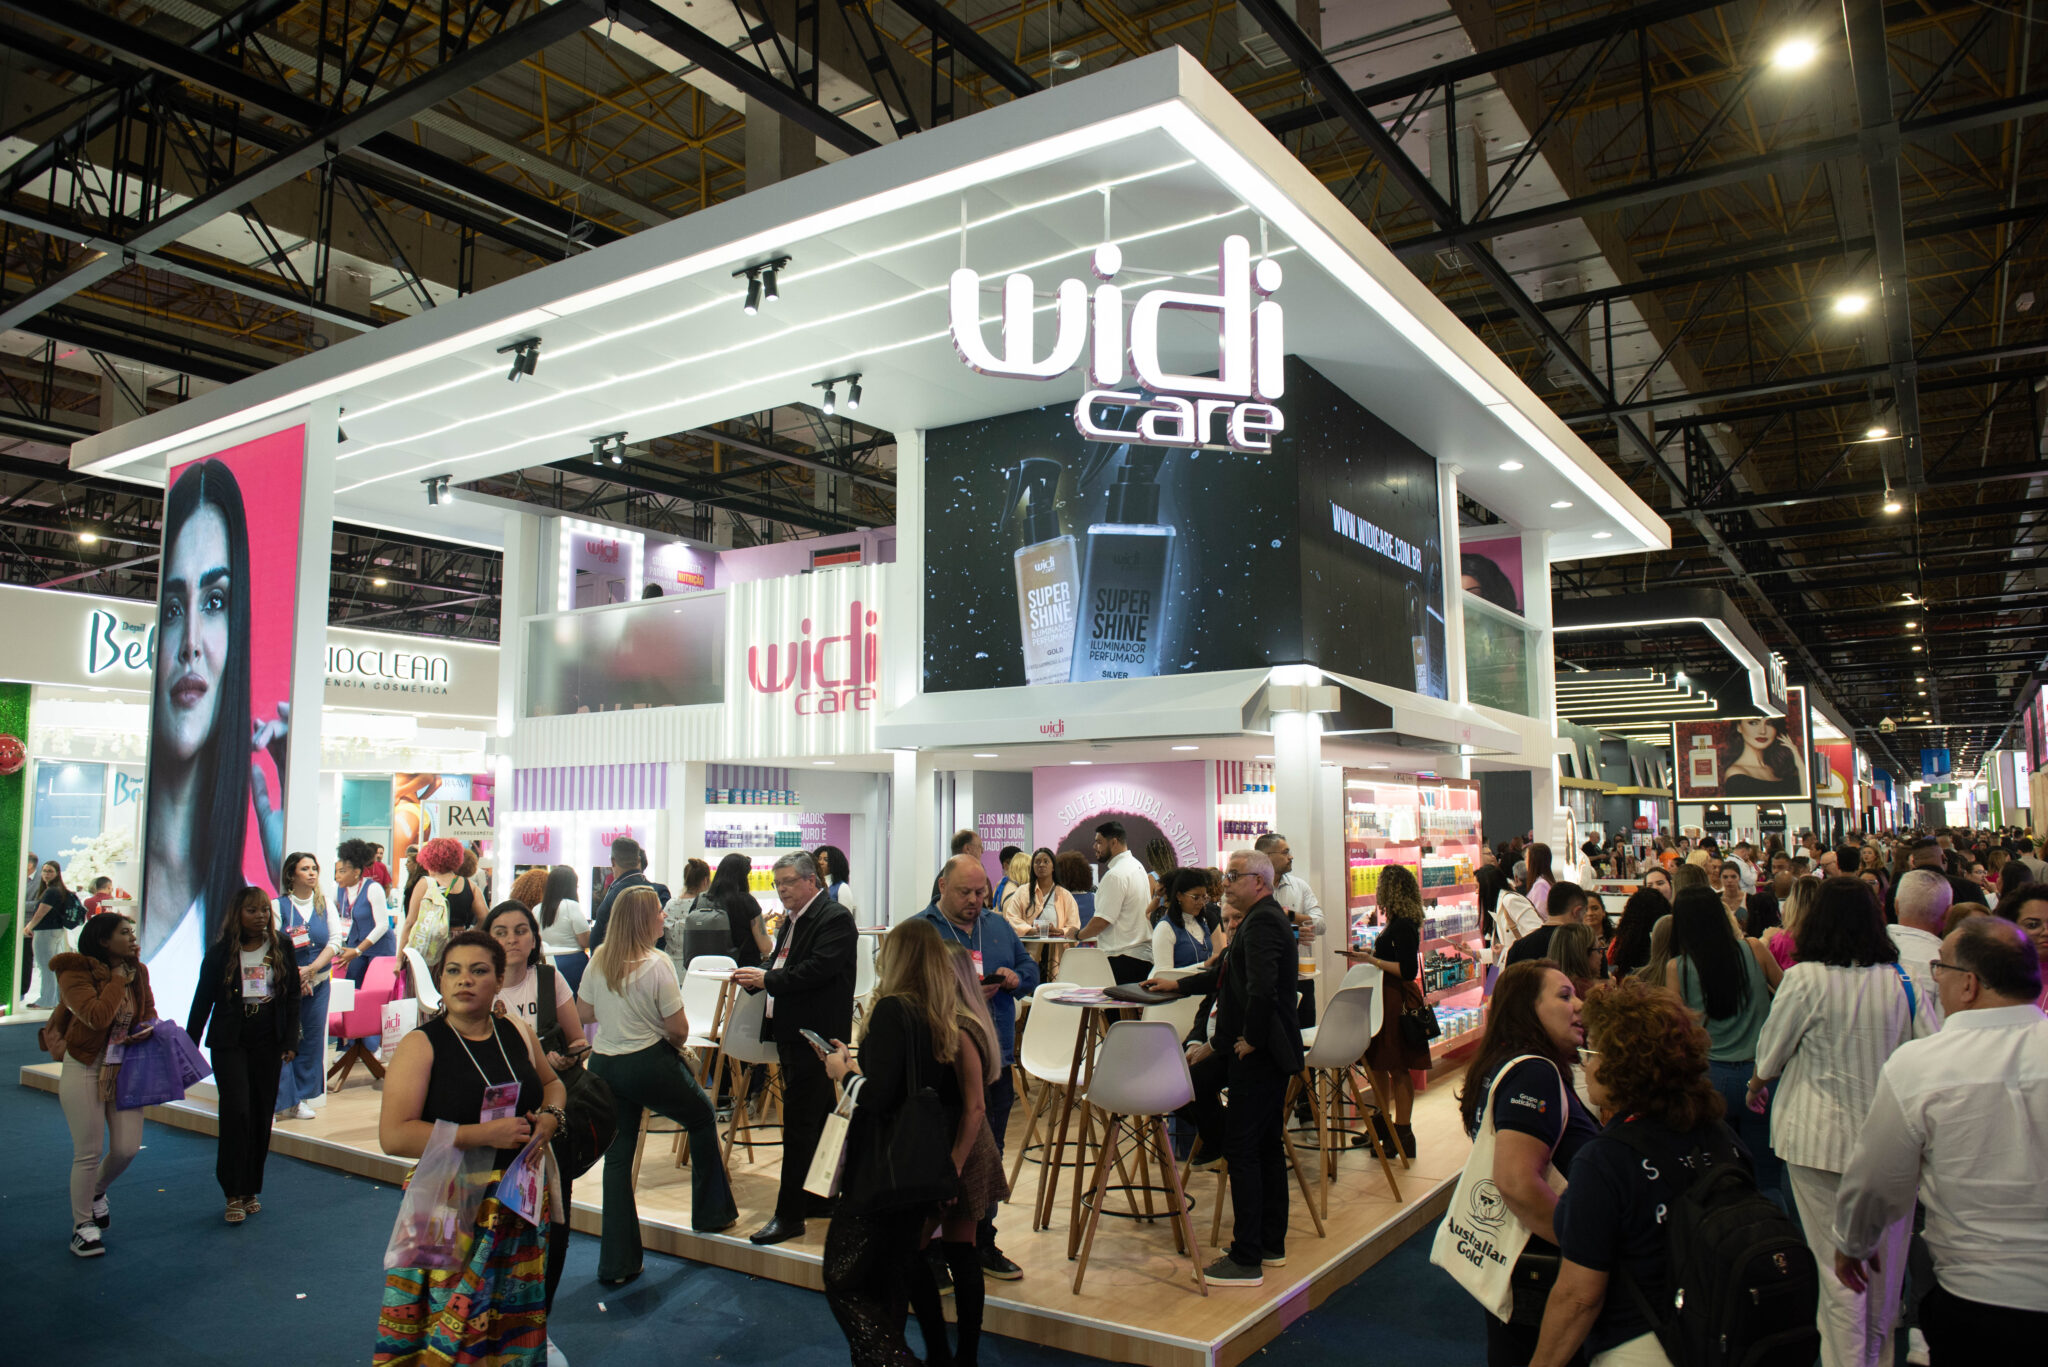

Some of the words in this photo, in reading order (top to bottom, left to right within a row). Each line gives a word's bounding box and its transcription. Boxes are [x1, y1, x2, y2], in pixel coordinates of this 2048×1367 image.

[949, 235, 1285, 400] widi
[1074, 389, 1285, 449] care
[586, 539, 619, 556] widi
[1331, 503, 1422, 573] WWW.WIDICARE.COM.BR
[1034, 555, 1056, 571] widi
[1028, 581, 1070, 609] SUPER
[1095, 588, 1150, 614] SUPER
[1029, 600, 1073, 630] SHINE
[1092, 613, 1149, 643] SHINE
[748, 600, 877, 693] widi
[1046, 646, 1064, 656] GOLD
[1089, 650, 1145, 664] PERFUMADO
[1090, 641, 1146, 654] ILUMINADOR
[325, 646, 448, 682] IOCLEAN
[1101, 670, 1128, 679] SILVER
[794, 687, 876, 715] care
[1040, 719, 1064, 733] widi
[448, 805, 490, 827] RAA
[996, 813, 1015, 825] MAIS
[1058, 791, 1096, 826] SOLTE
[1098, 786, 1124, 805] SUA
[1128, 789, 1162, 819] JUBA
[1161, 810, 1175, 827] E
[1169, 821, 1200, 868] SINTA
[523, 825, 550, 846] widi
[979, 827, 989, 839] TO
[990, 827, 1007, 839] LISO
[1510, 1097, 1537, 1109] Boticário
[1520, 1093, 1538, 1103] Grupo
[1448, 1216, 1508, 1266] Australian
